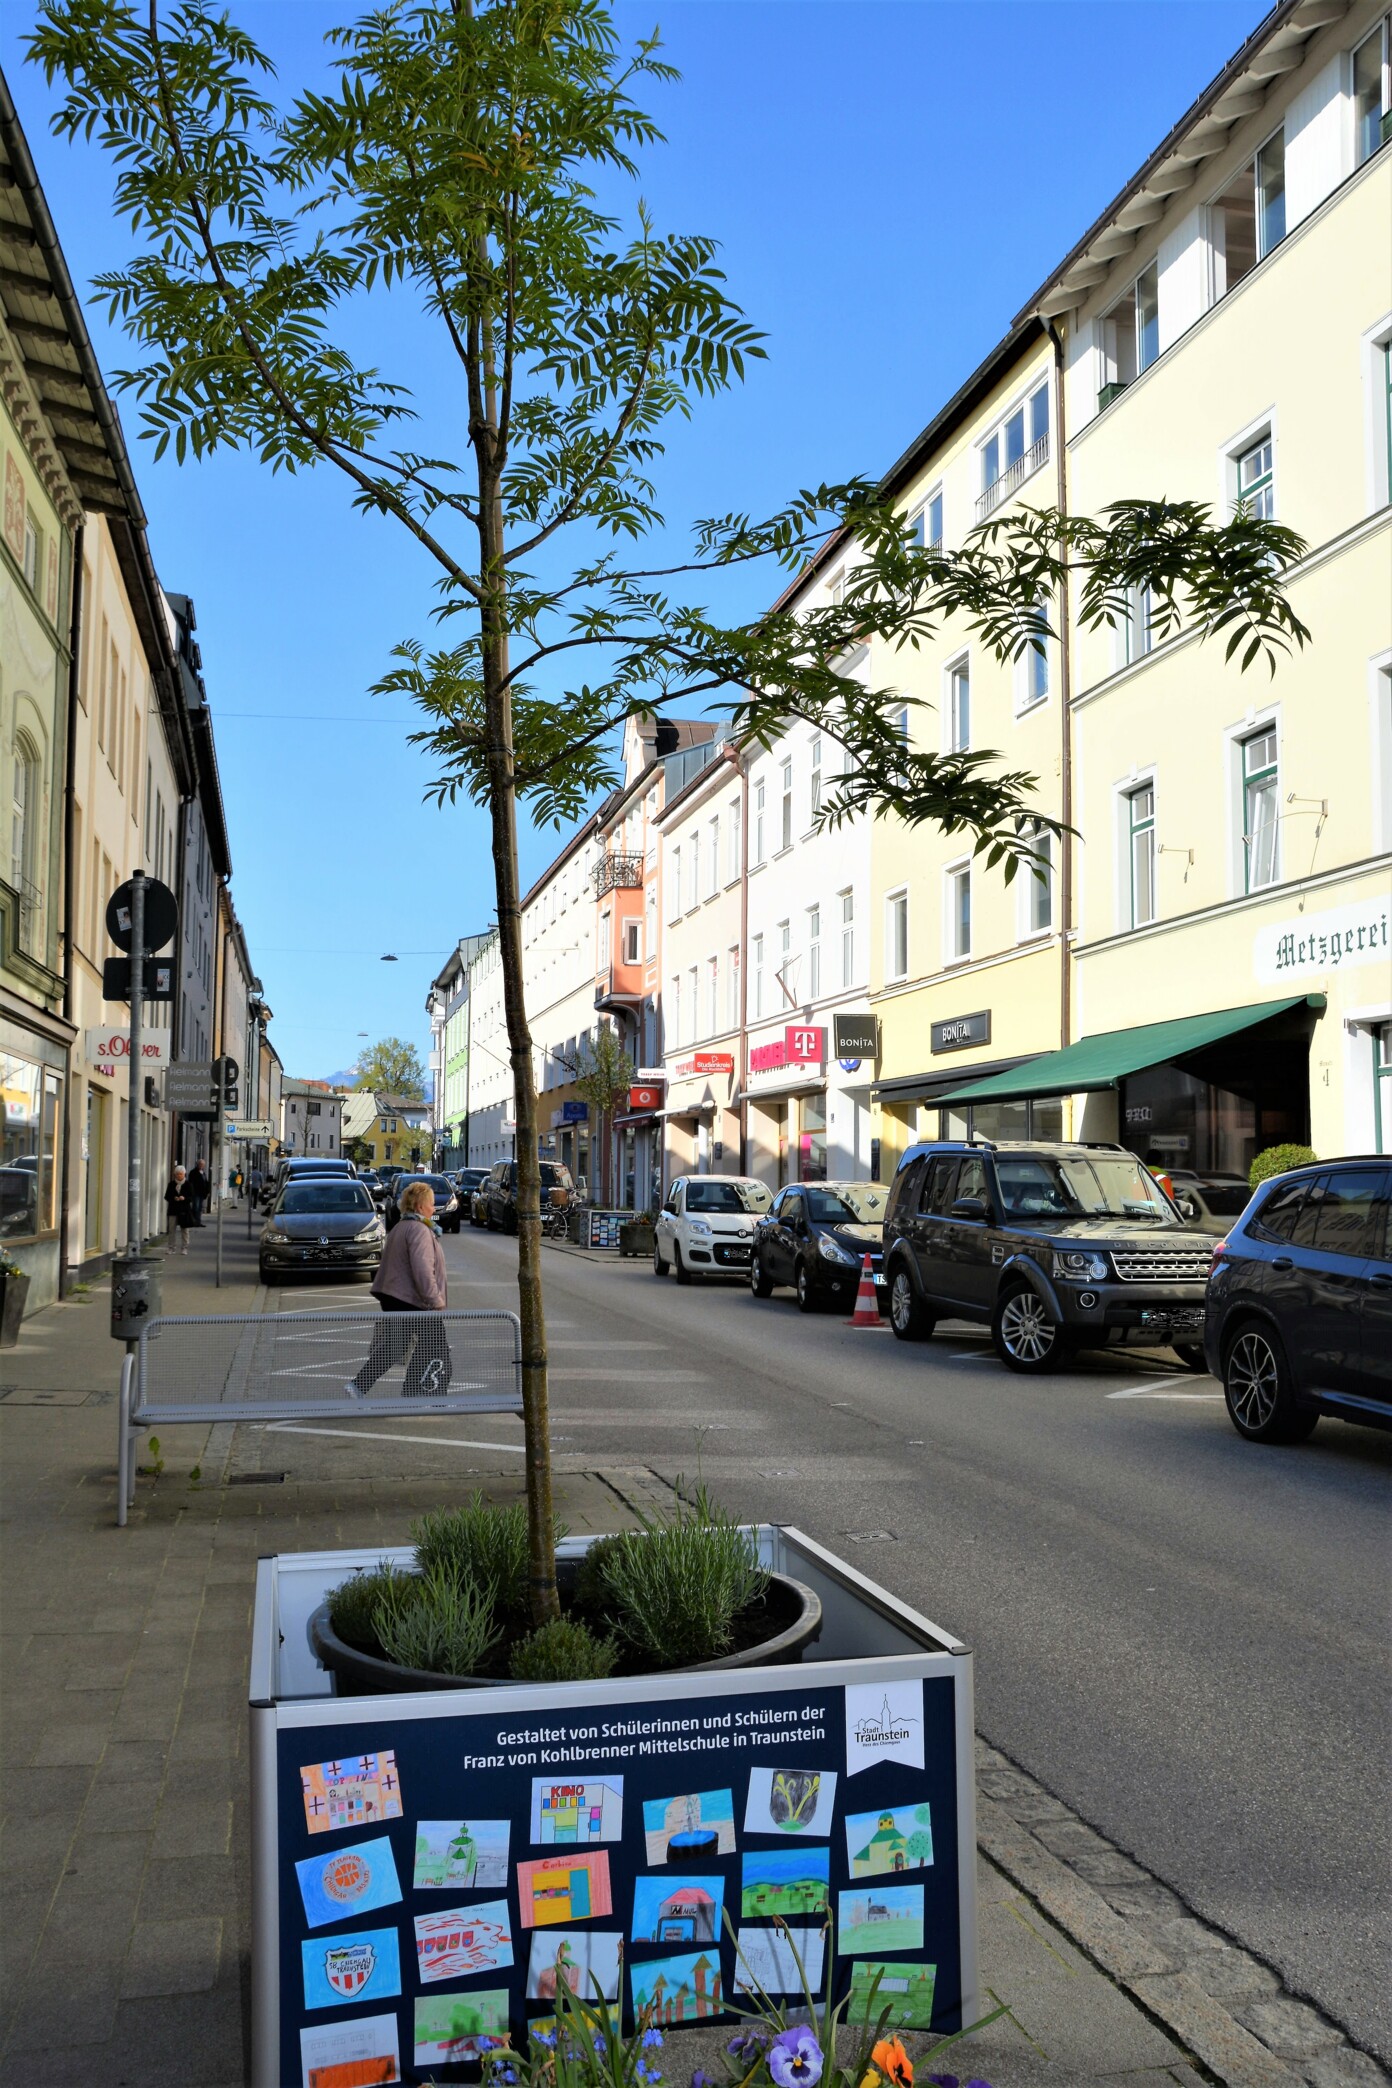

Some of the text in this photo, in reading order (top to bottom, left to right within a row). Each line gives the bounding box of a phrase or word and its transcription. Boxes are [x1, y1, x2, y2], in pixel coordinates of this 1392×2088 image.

[1276, 914, 1387, 969] Metzgerei
[497, 1706, 826, 1746] Gestaltet von Schülerinnen und Schülern der
[854, 1728, 910, 1743] Traunstein
[464, 1726, 826, 1770] Franz von Kohlbrenner Mittelschule in Traunstein
[551, 1785, 585, 1797] KINO
